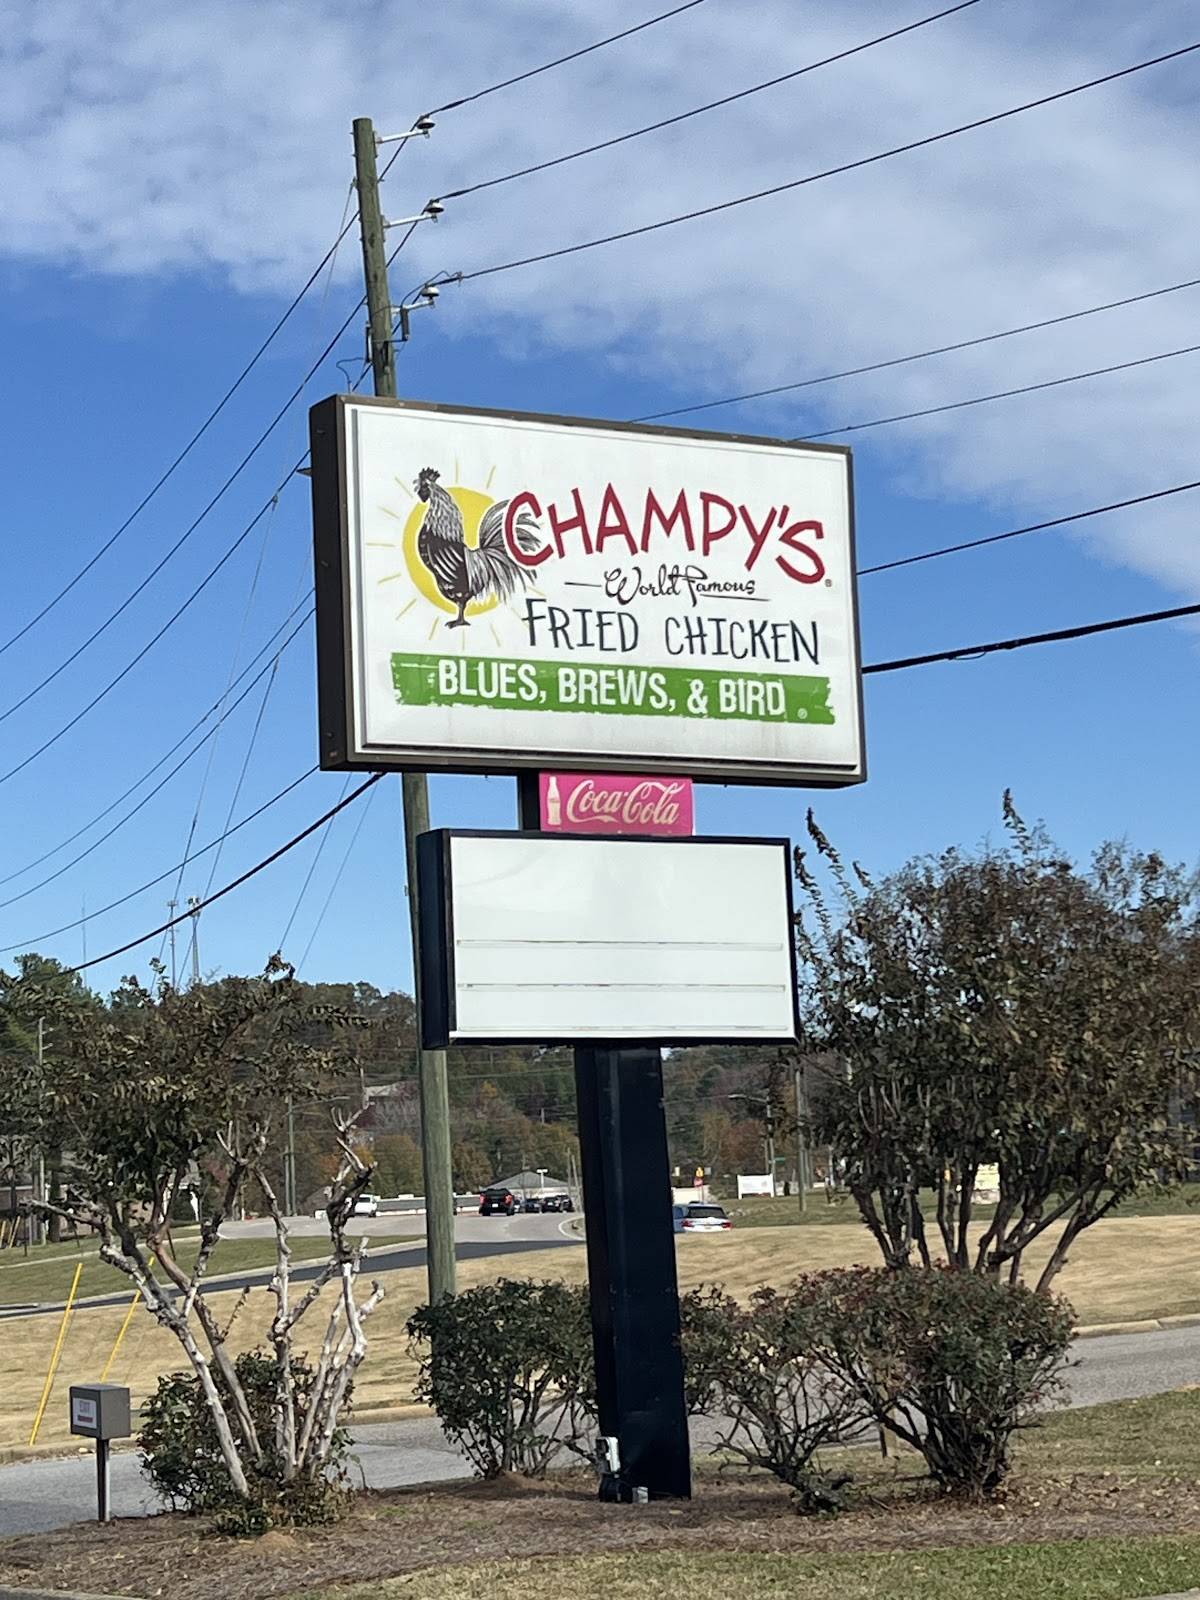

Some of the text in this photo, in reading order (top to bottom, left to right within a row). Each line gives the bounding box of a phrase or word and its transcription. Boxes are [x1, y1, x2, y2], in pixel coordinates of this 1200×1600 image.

[505, 483, 824, 584] CHAMPY'S
[604, 564, 756, 607] World Famous
[521, 598, 820, 665] FRIED CHICKEN
[438, 658, 786, 717] BLUES, BREWS, & BIRD
[566, 779, 685, 825] Coca-Cola
